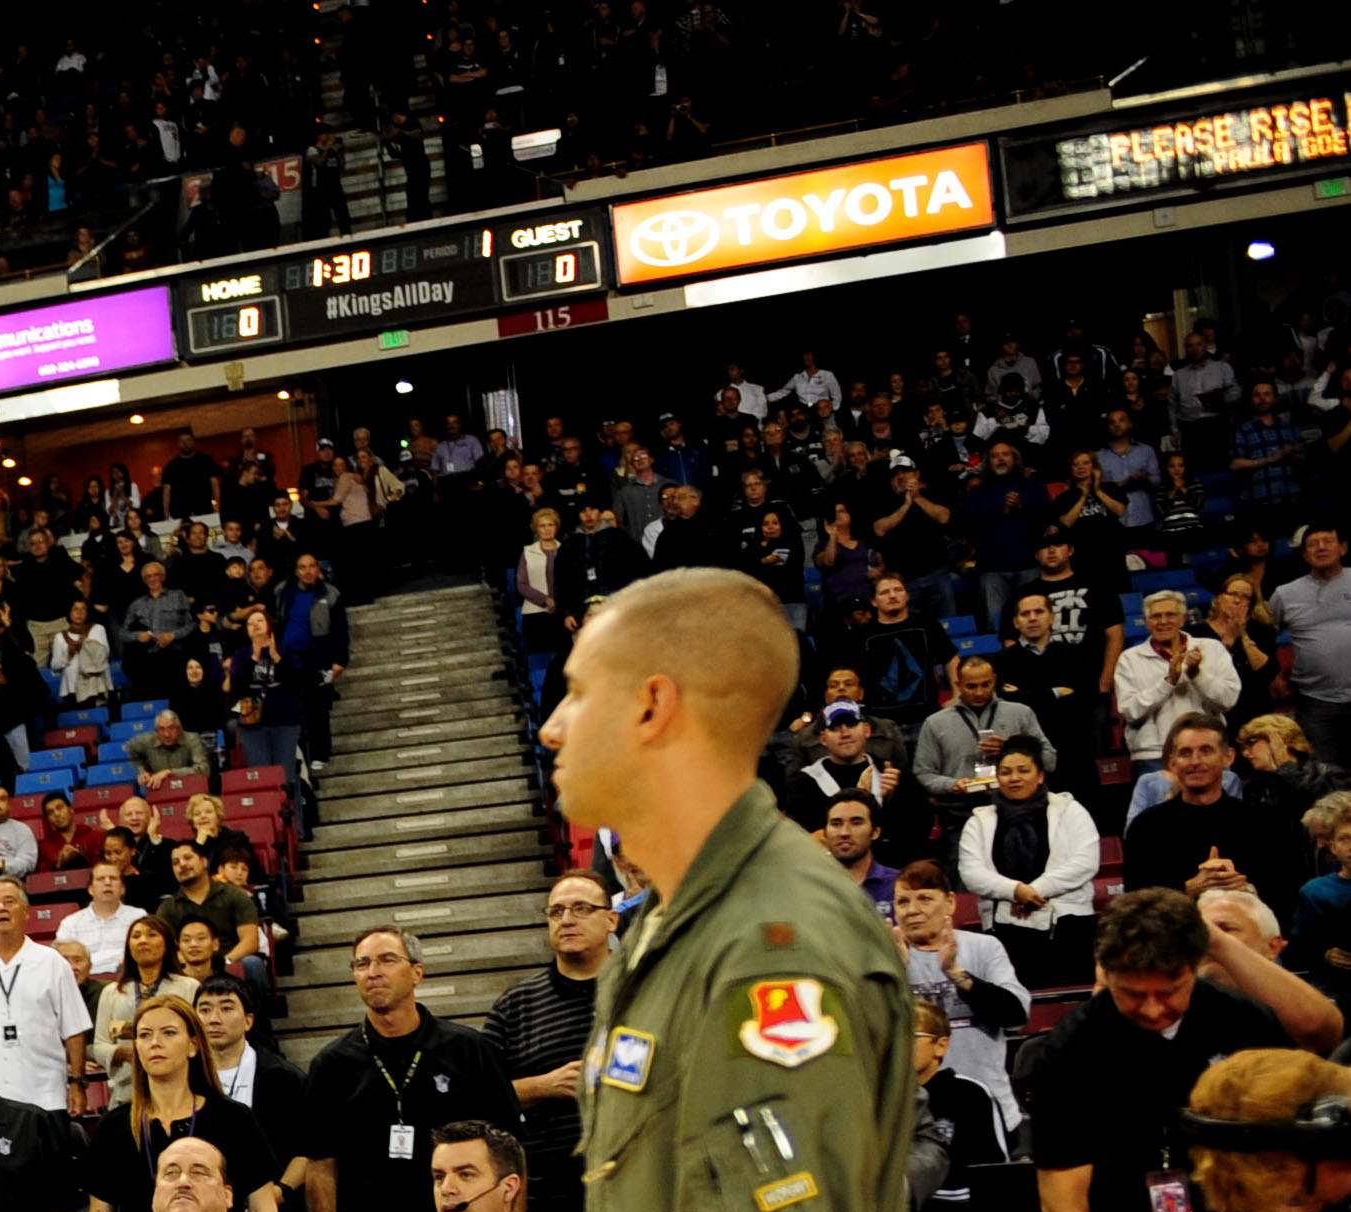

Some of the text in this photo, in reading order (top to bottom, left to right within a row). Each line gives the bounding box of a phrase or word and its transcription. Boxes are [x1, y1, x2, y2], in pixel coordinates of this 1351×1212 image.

[1110, 98, 1335, 166] PLEASE RISE
[1299, 131, 1351, 160] GOE
[723, 170, 973, 246] TOYOTA
[511, 220, 583, 249] GUEST
[423, 244, 458, 261] PERIOD
[312, 251, 371, 287] 1:30
[201, 275, 263, 302] HOME
[326, 280, 454, 320] #KingsAllDay
[533, 306, 572, 331] 115
